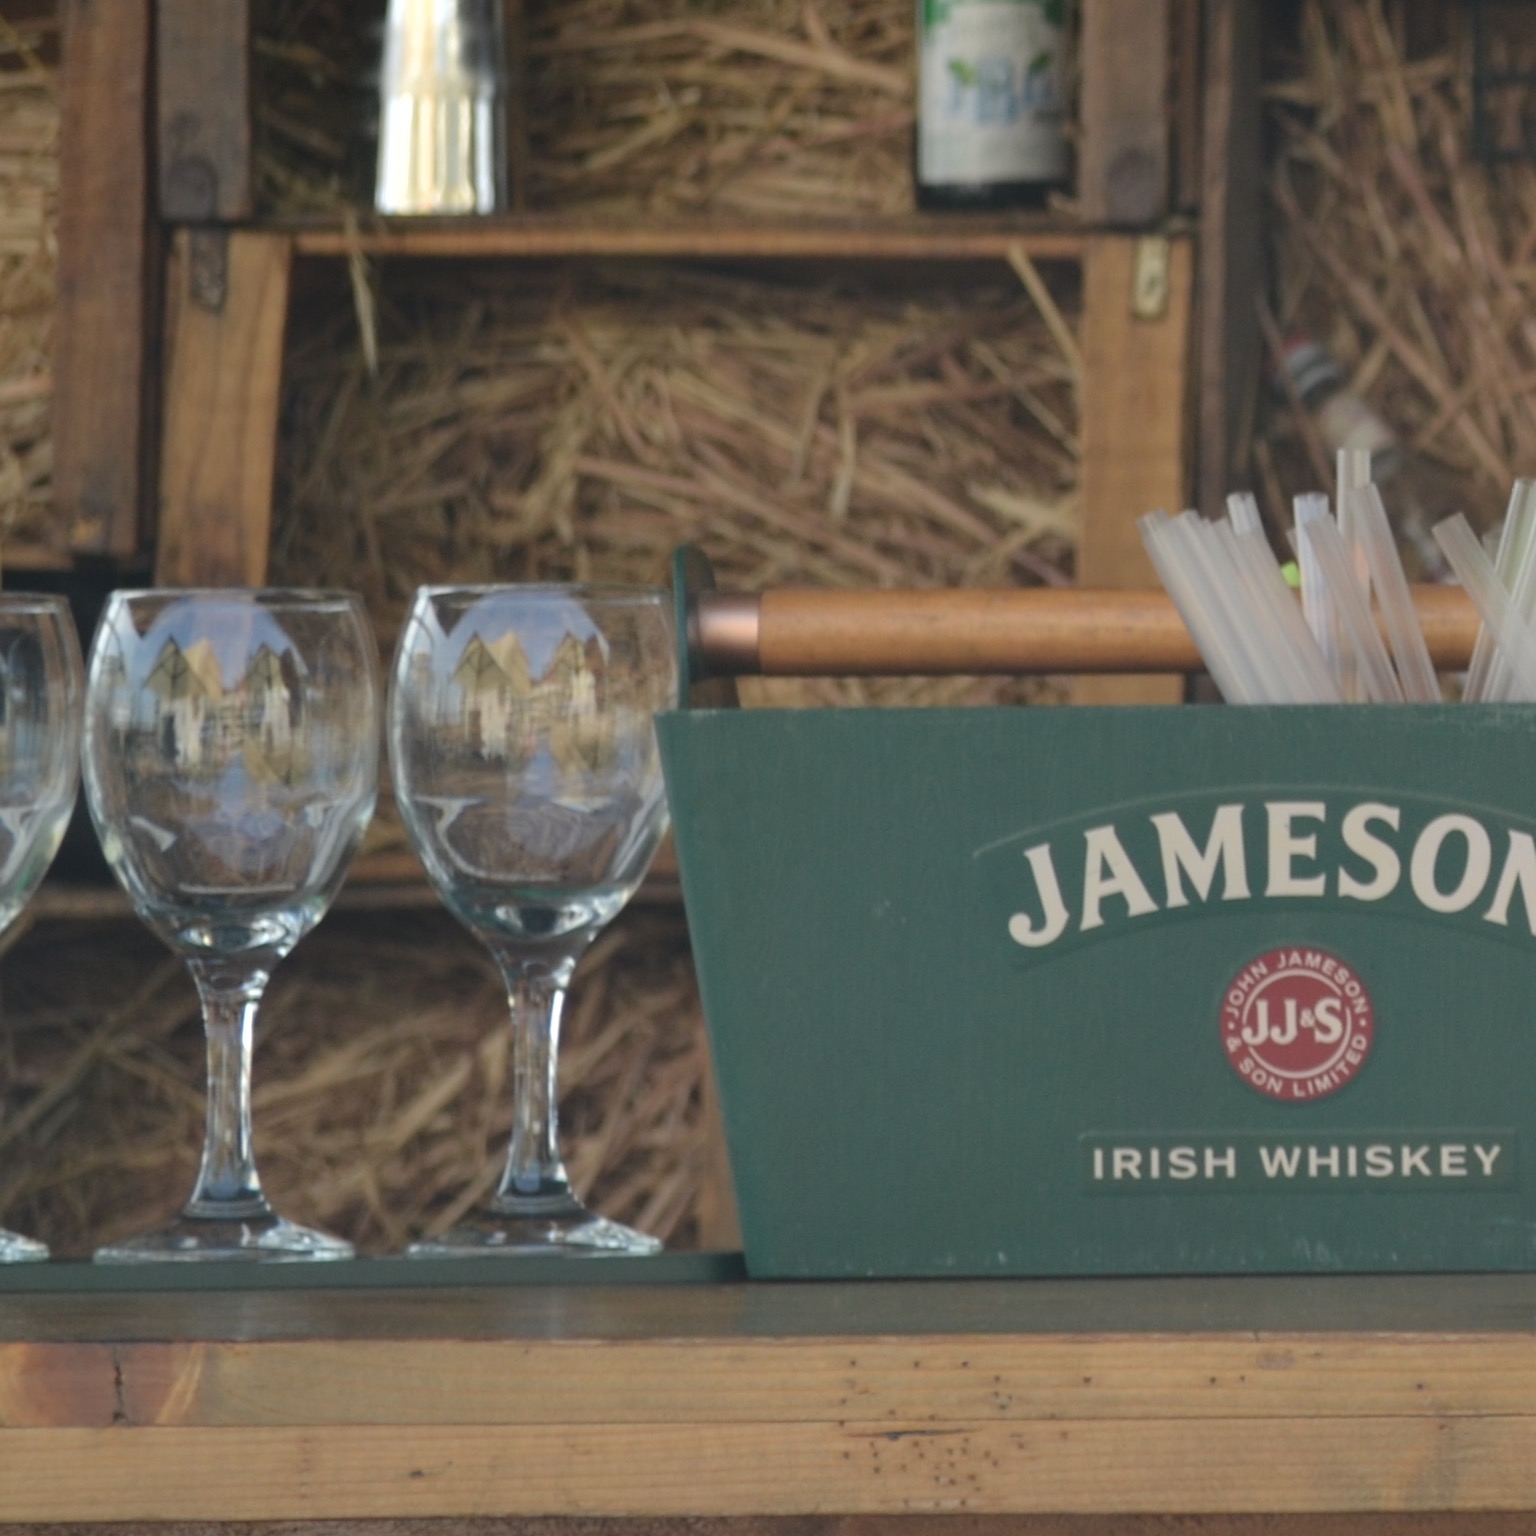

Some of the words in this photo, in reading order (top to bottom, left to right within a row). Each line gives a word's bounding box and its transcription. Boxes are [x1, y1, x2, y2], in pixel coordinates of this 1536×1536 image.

[1226, 961, 1268, 1019] JOHN
[1277, 950, 1369, 1015] JAMESON
[1241, 997, 1344, 1046] JJ&S
[1226, 1035, 1243, 1054] &
[1238, 1057, 1284, 1095] SON
[1292, 1034, 1368, 1098] LIMITED
[1092, 1147, 1238, 1180] IRISH
[1257, 1144, 1502, 1178] WHISKEY
